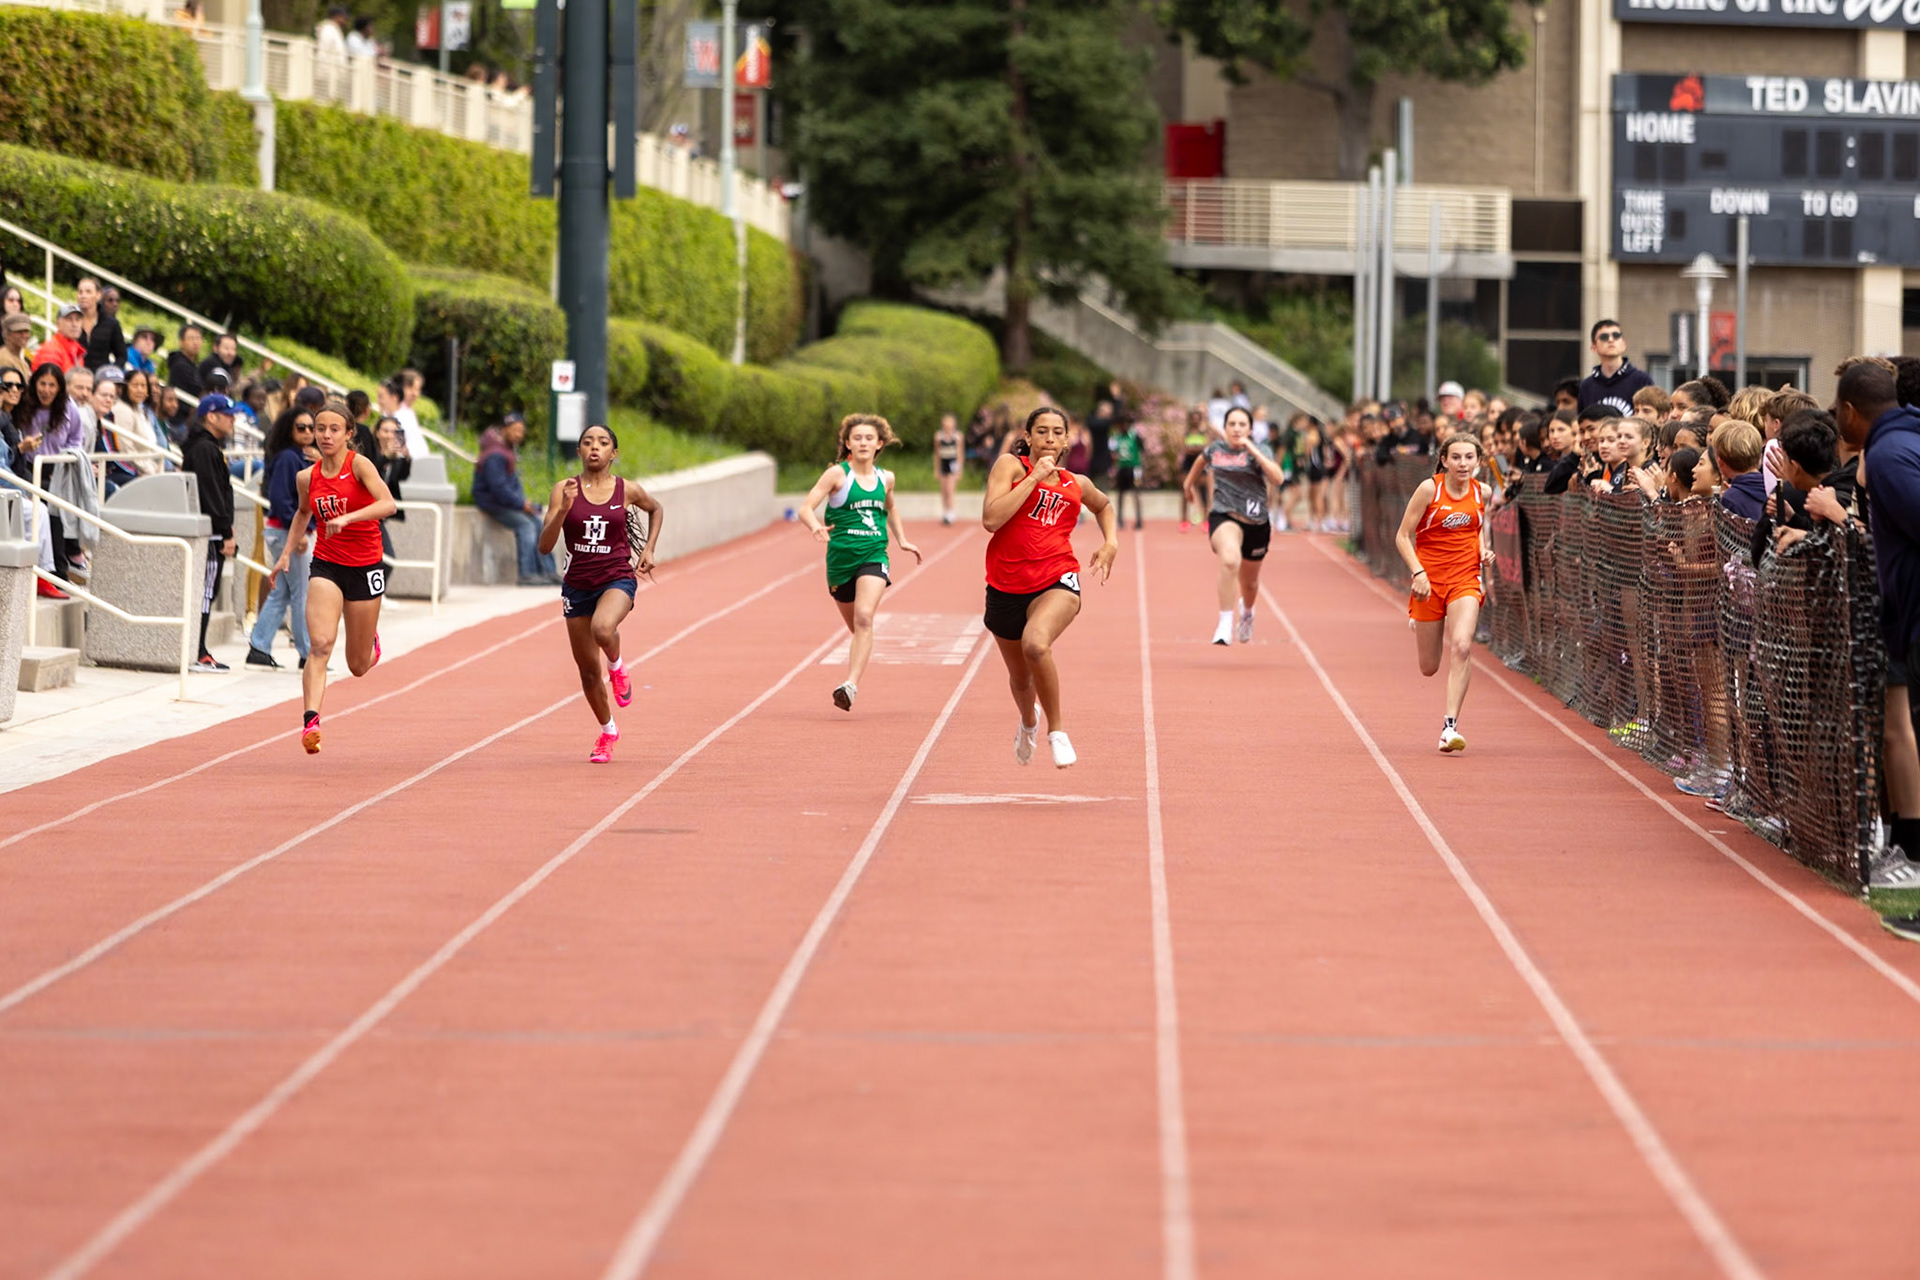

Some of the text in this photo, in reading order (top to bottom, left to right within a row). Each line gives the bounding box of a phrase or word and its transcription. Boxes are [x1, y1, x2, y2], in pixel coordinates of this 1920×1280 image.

[1746, 76, 1809, 112] TED
[1625, 112, 1696, 143] HOME
[1623, 190, 1665, 213] TIME
[1710, 188, 1770, 215] DOWN
[1801, 190, 1859, 218] TO GO
[1620, 211, 1665, 233] OUTS
[1622, 232, 1662, 253] LEFT
[1248, 500, 1258, 516] 2
[574, 543, 591, 553] TRACK
[596, 545, 611, 554] FIELD
[371, 571, 383, 592] 6
